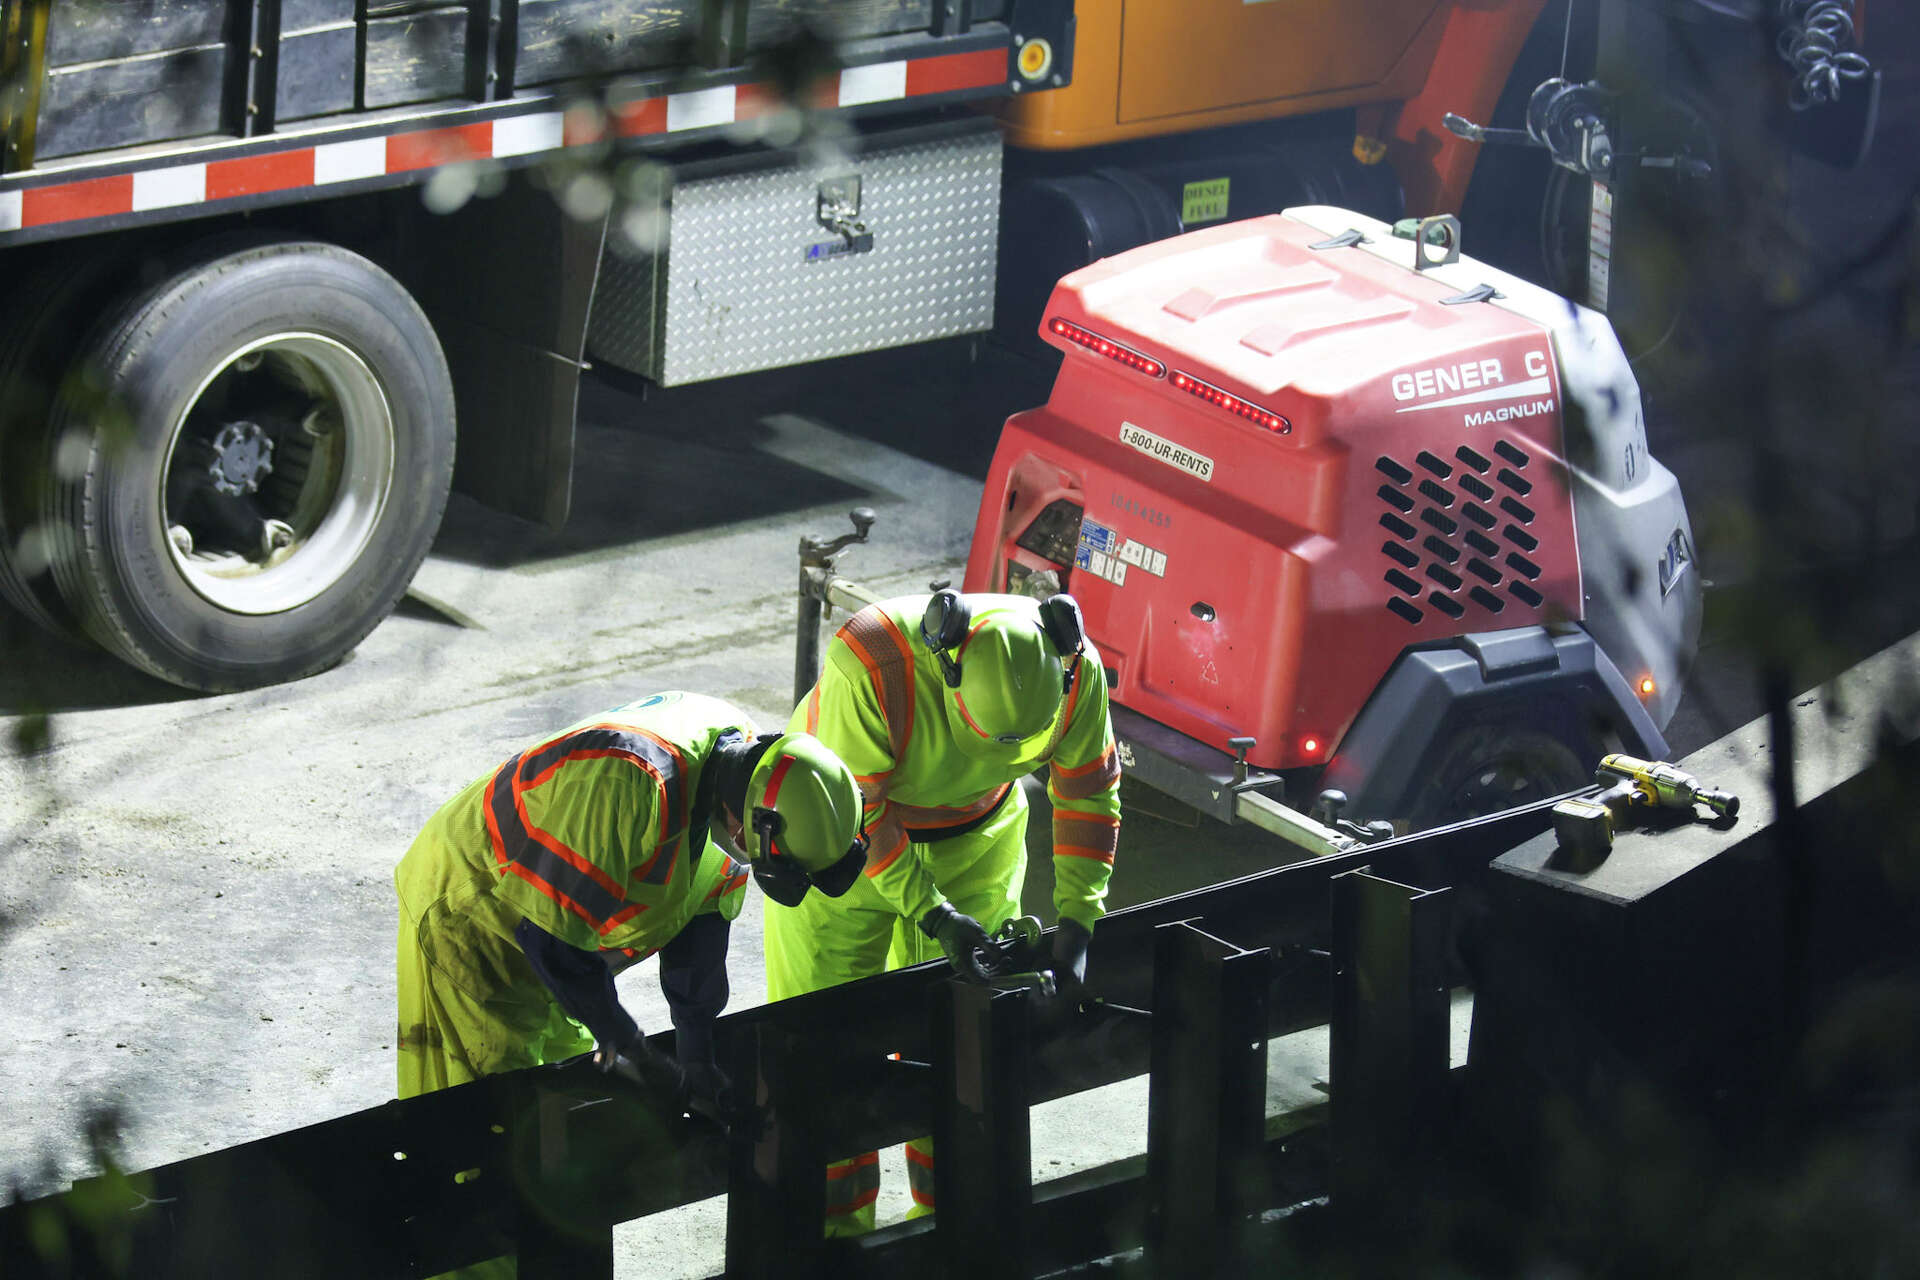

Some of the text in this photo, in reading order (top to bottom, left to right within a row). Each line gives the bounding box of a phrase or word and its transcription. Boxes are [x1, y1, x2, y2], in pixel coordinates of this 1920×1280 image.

[1184, 184, 1225, 200] DIESEL
[1464, 399, 1554, 427] MAGNUM
[1123, 428, 1210, 475] 1-800-UR-RENTS
